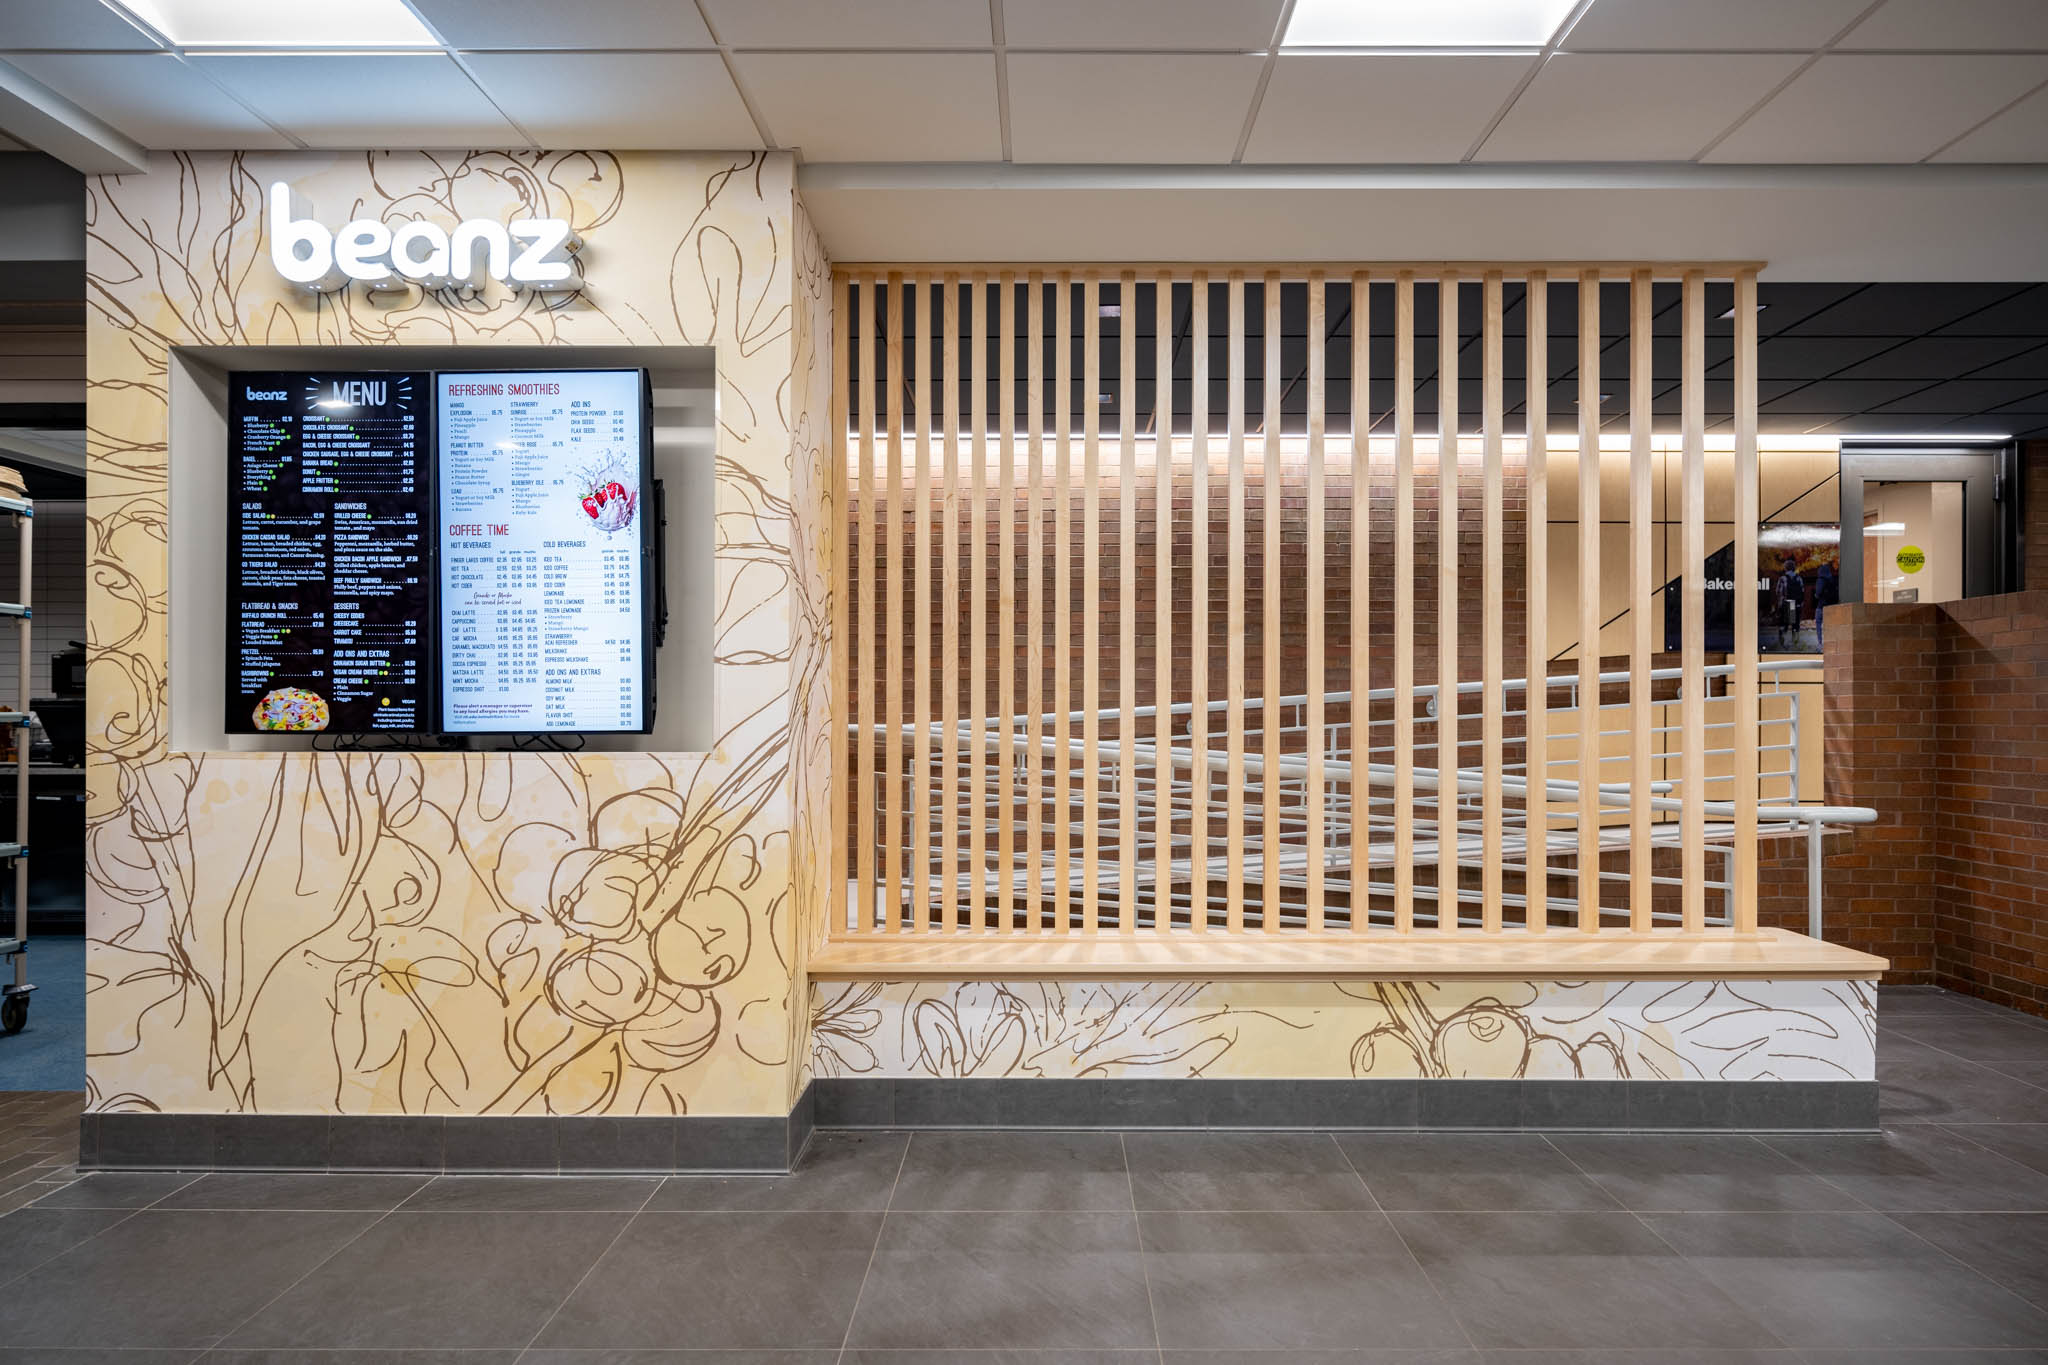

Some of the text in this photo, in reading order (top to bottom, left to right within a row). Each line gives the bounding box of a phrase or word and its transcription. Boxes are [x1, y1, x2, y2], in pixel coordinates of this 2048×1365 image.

[270, 181, 572, 283] beanz
[246, 386, 287, 401] beanz
[333, 381, 388, 406] MENU
[449, 384, 560, 396] REFRESHING SMOOTHIES
[449, 524, 510, 536] COFFEE TIME
[1704, 577, 1736, 590] ake
